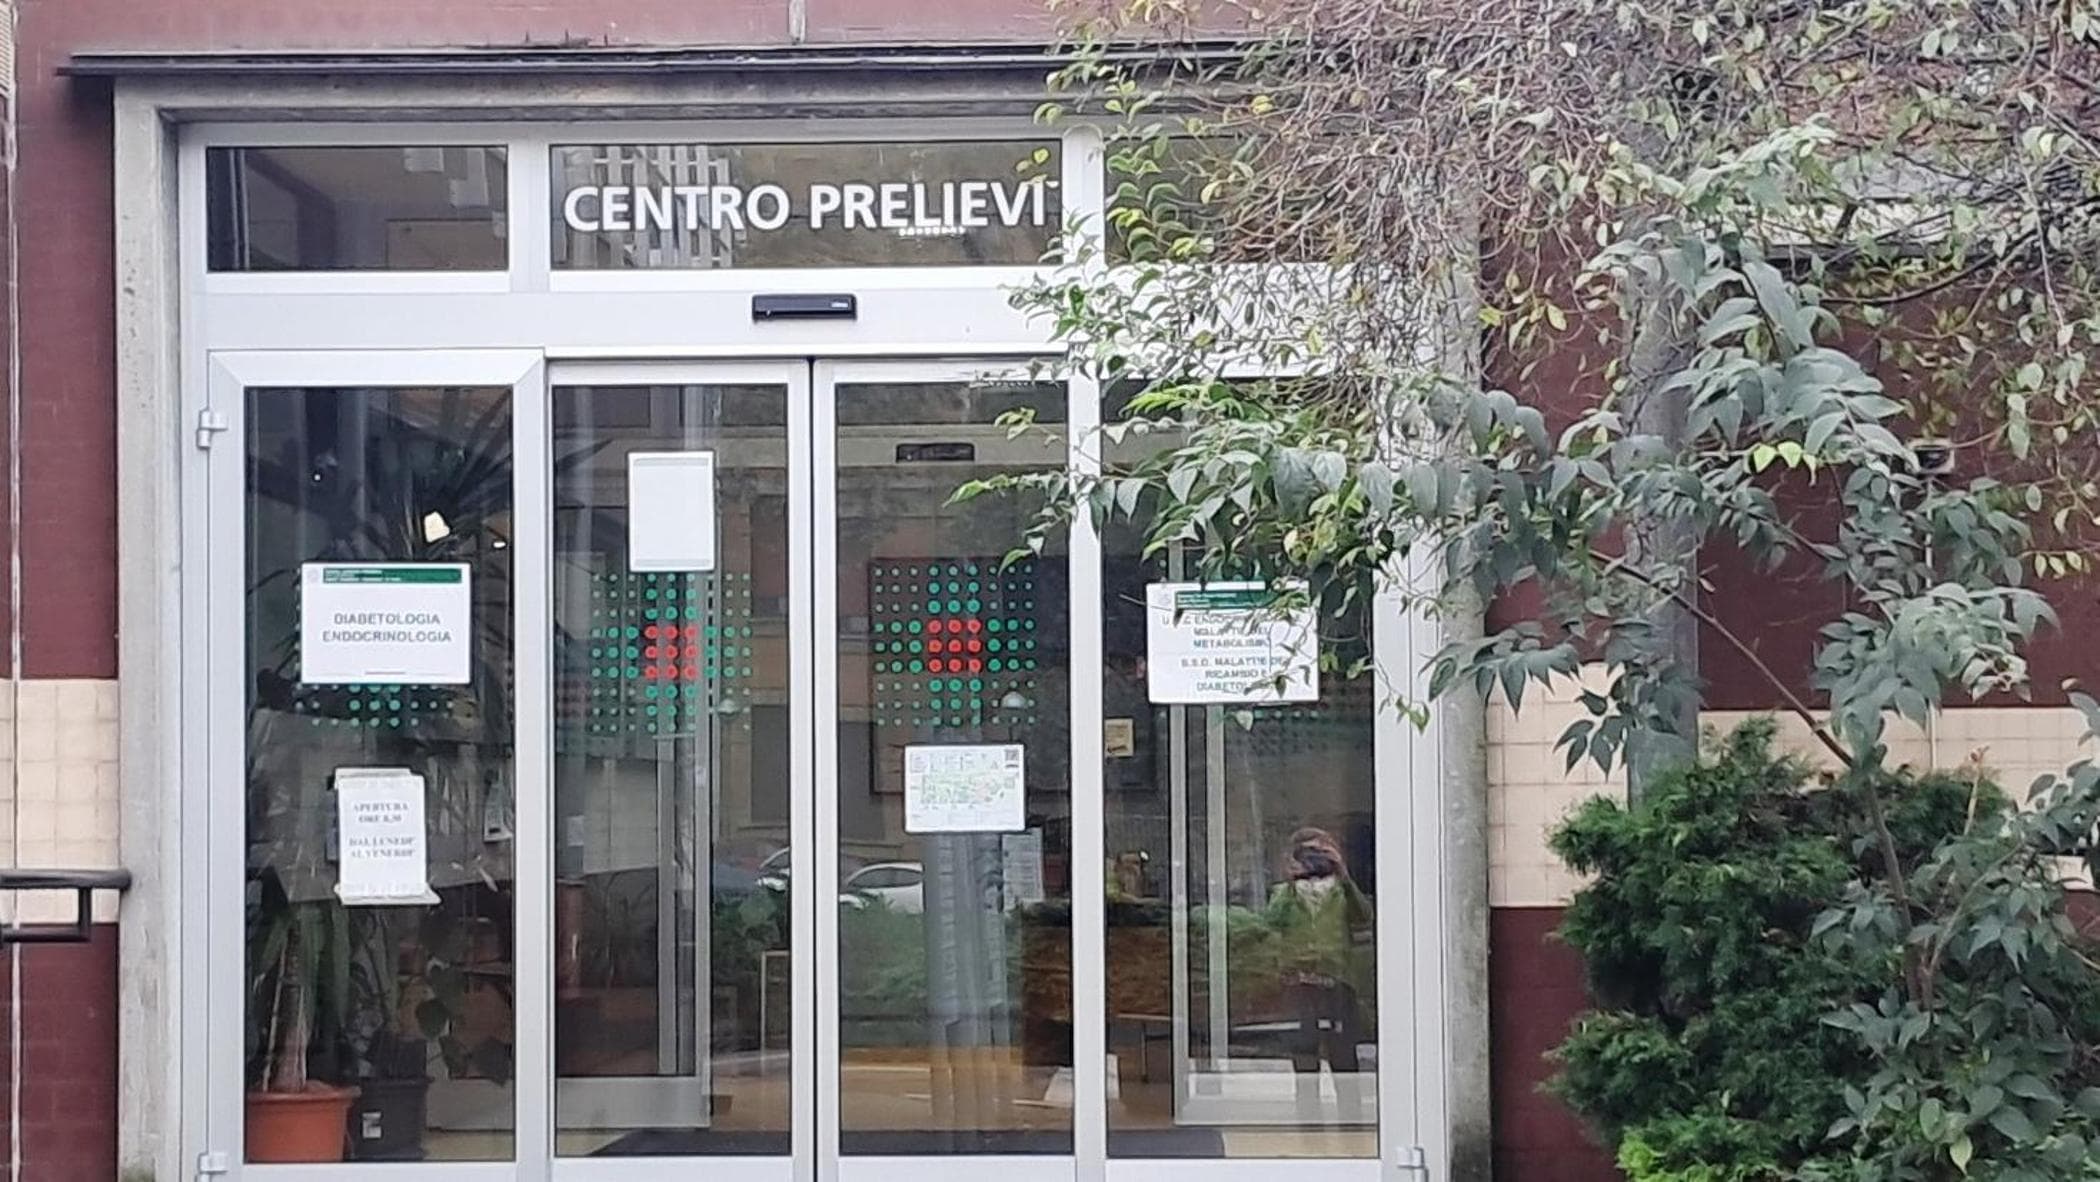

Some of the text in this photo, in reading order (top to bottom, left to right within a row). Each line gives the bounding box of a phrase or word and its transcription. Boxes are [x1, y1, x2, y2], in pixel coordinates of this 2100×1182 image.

[564, 180, 1046, 232] CENTRO PRELIEVI
[334, 613, 441, 625] DIABETOLOGIA
[322, 630, 452, 643] ENDOCRINOLOGIA
[1204, 669, 1256, 680] RICAMBIO
[354, 803, 408, 812] APERTURA
[359, 815, 380, 823] ORE
[350, 837, 370, 847] DAL
[352, 849, 364, 858] AL
